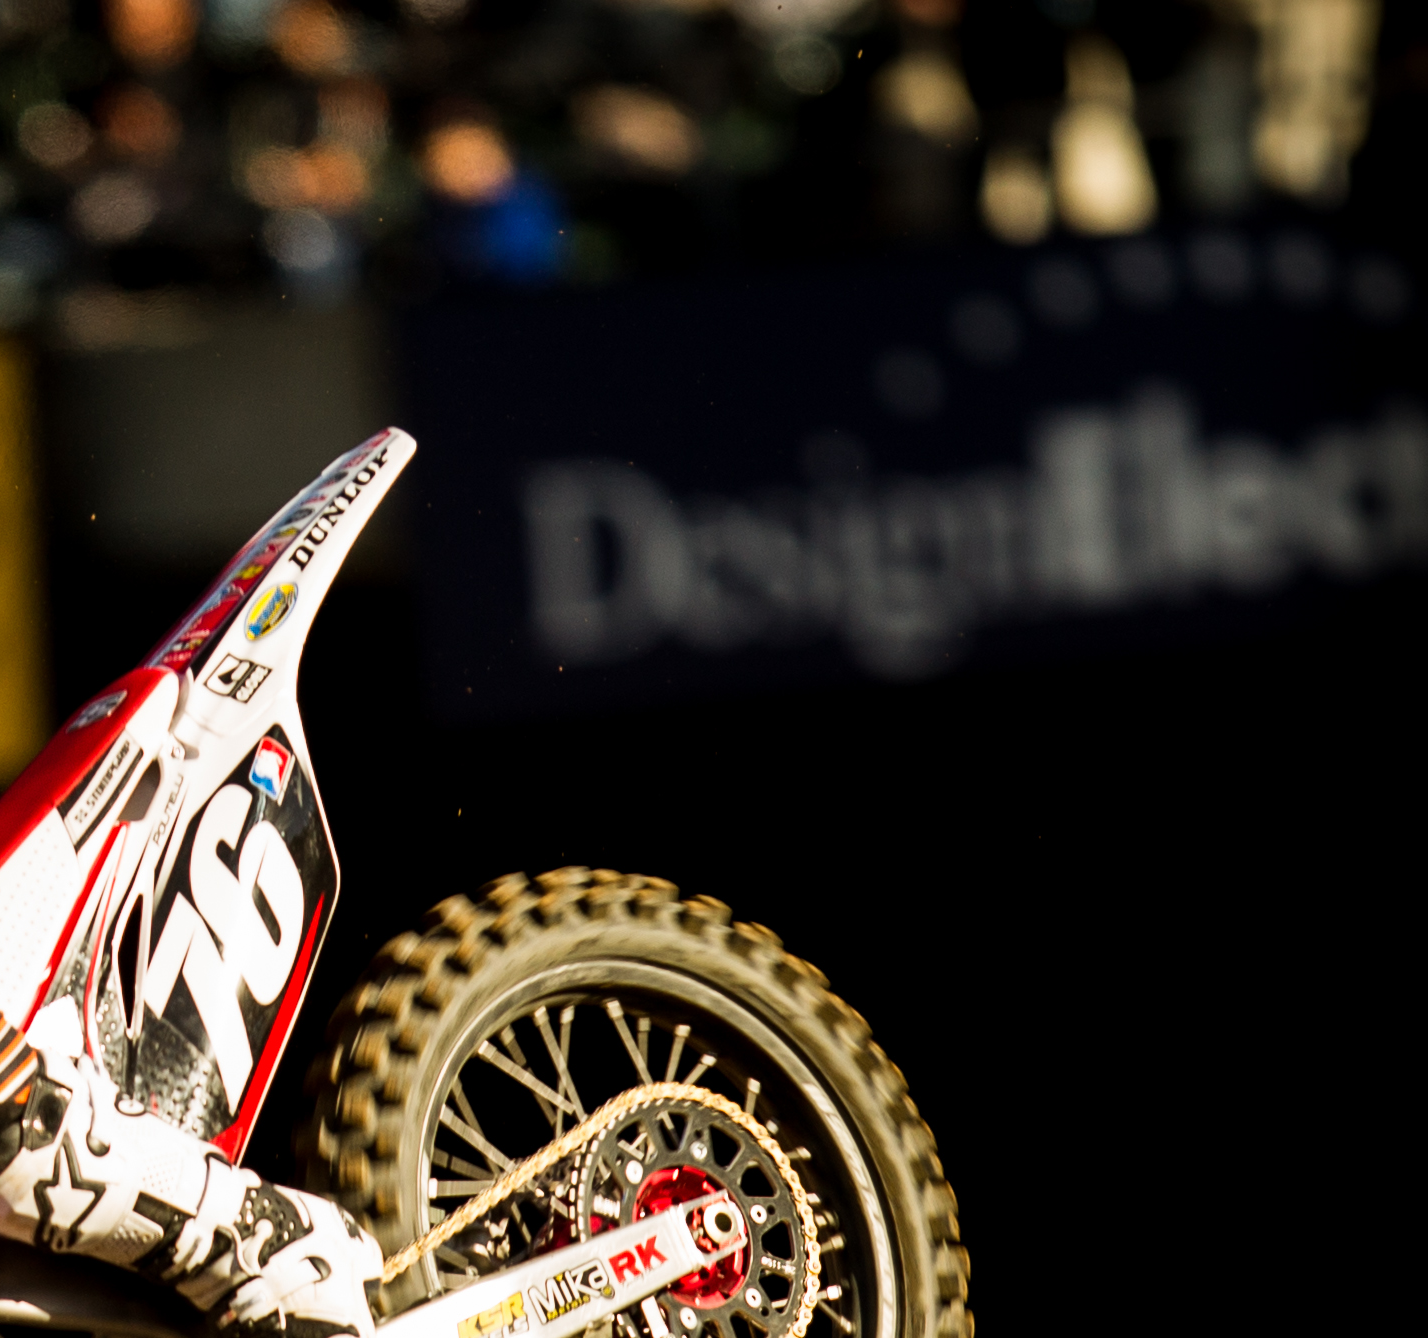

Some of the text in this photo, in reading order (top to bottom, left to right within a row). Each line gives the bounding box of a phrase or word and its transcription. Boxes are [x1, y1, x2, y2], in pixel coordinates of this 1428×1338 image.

[144, 783, 305, 1117] 76
[528, 1258, 610, 1326] Mika
[608, 1235, 669, 1285] RK
